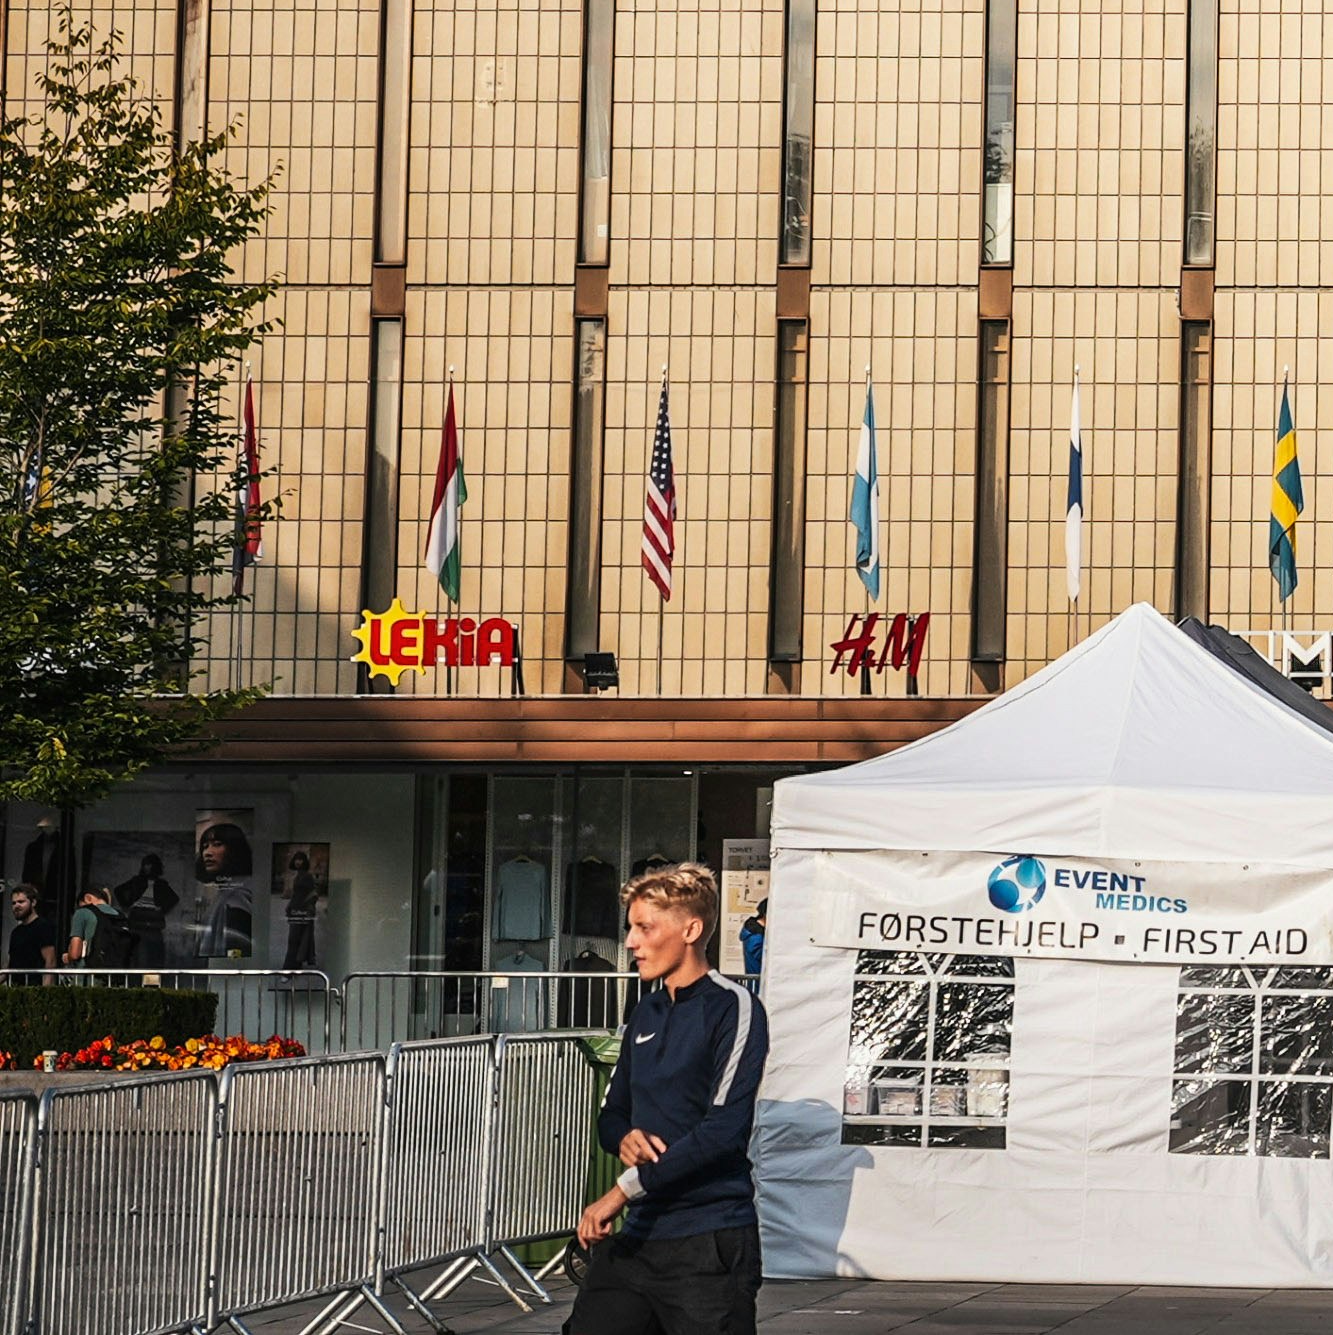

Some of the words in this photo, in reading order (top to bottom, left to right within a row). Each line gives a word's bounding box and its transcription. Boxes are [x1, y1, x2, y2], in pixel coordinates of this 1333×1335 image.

[830, 611, 931, 677] H&M
[1054, 869, 1147, 893] EVENT
[1095, 893, 1188, 914] MEDICS
[859, 913, 1100, 950] FØRSTEHJELP
[1143, 927, 1242, 955] FIRST
[1250, 928, 1308, 956] AID
